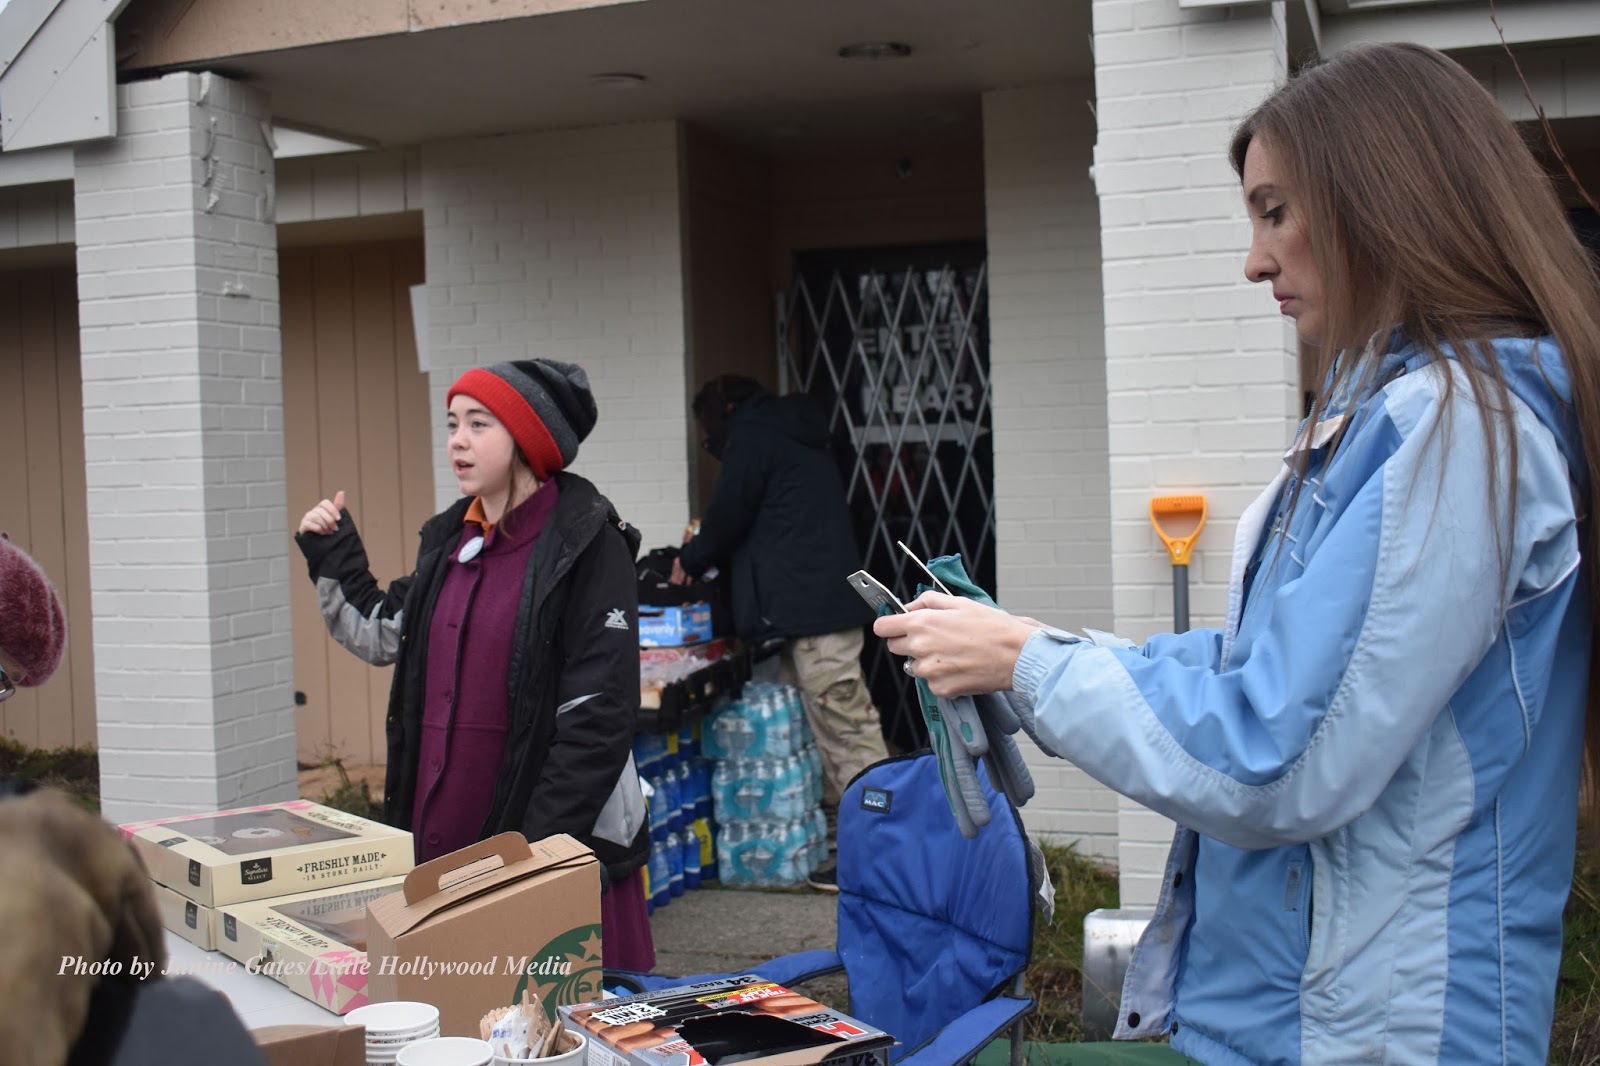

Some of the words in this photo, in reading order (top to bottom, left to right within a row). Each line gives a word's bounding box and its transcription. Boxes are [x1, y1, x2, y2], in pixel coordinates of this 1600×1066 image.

[856, 324, 978, 354] ENTER
[862, 383, 974, 415] REAR
[864, 799, 884, 807] MAC
[304, 856, 350, 873] FRESHLY
[353, 852, 380, 865] MADE
[321, 869, 349, 879] STORE
[691, 981, 724, 989] BAGS
[726, 977, 757, 986] 34
[740, 993, 760, 1002] TIE
[759, 990, 786, 998] TRUE
[605, 1010, 636, 1019] MIL
